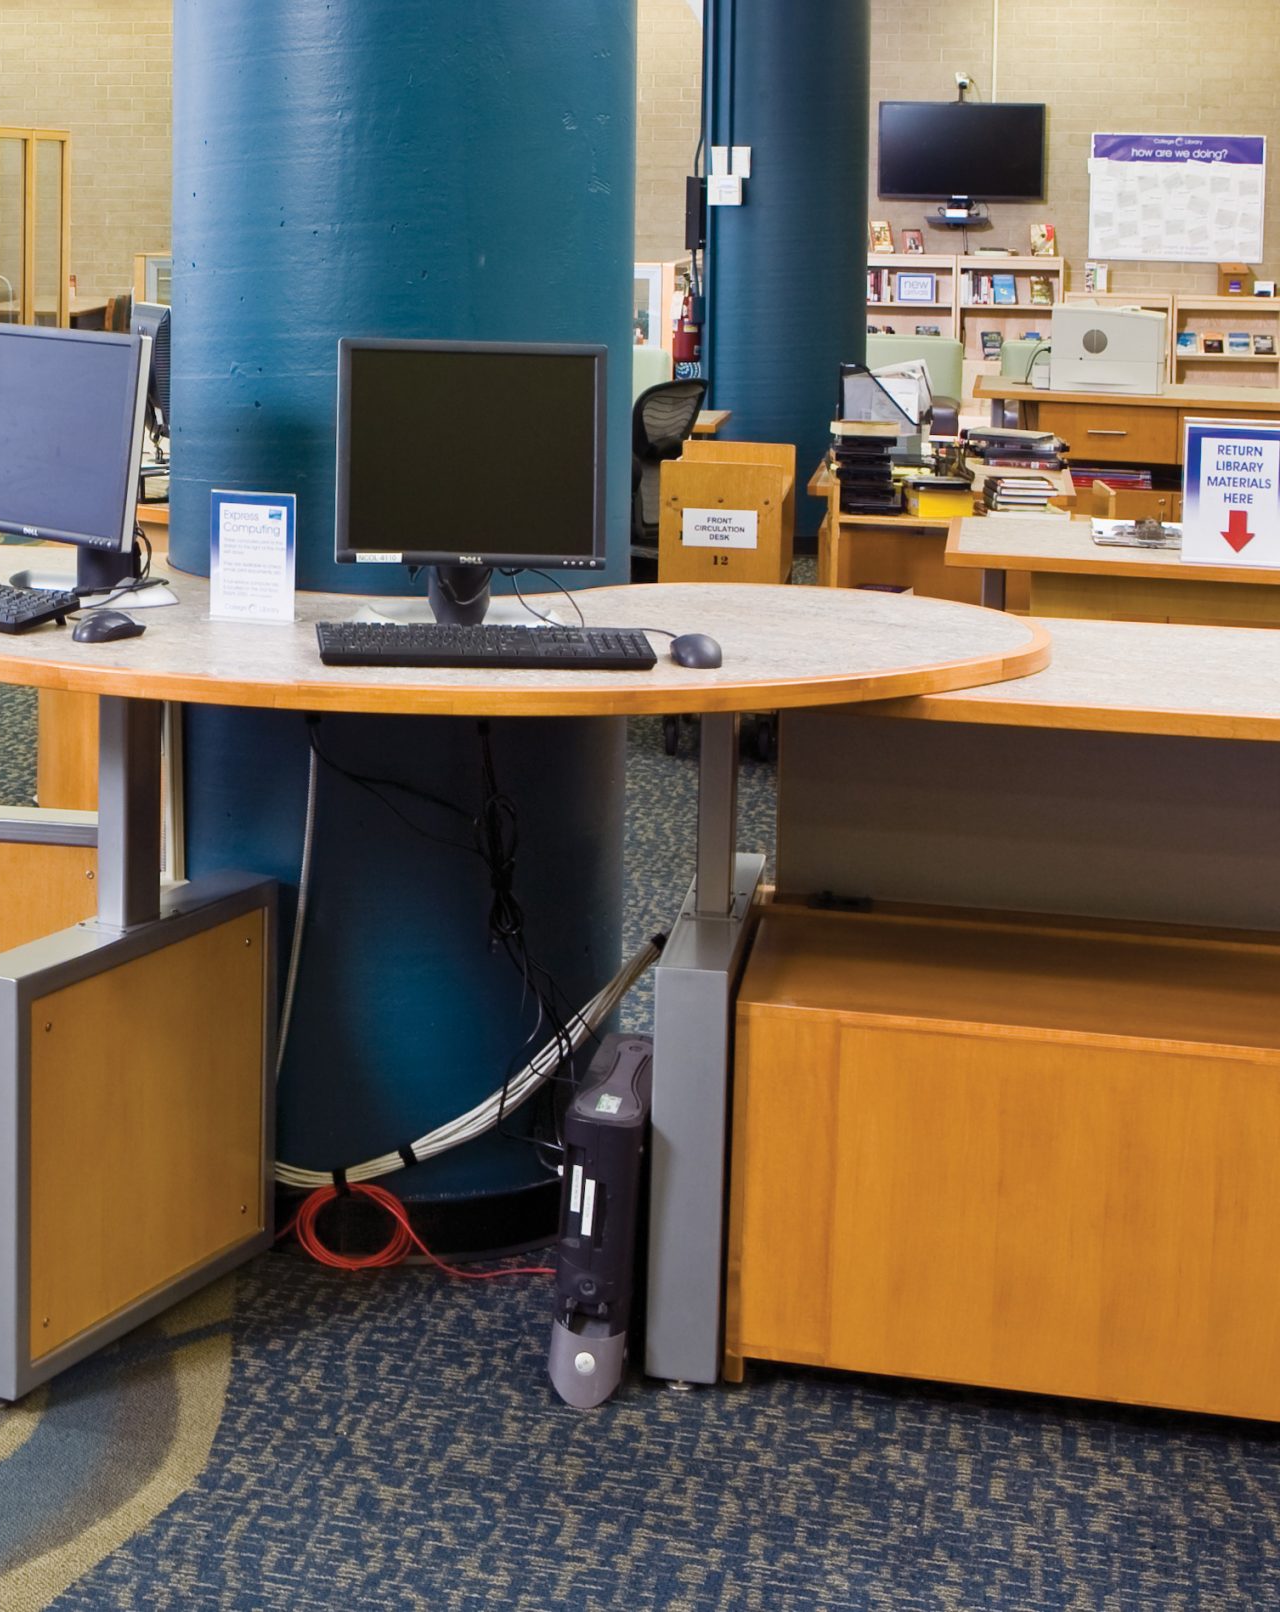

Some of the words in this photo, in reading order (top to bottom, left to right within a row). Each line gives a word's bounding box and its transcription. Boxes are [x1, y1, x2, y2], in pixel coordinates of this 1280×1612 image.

[1184, 138, 1203, 147] Library
[1131, 148, 1153, 158] how
[1155, 149, 1173, 158] are
[1174, 149, 1190, 158] we
[1193, 149, 1228, 161] doing?
[904, 280, 929, 289] new
[1217, 444, 1263, 457] RETURN
[1216, 460, 1264, 473] LIBRARY
[1206, 475, 1272, 490] MATERIALS
[1223, 492, 1254, 504] HERE
[223, 509, 259, 522] Express
[706, 516, 733, 524] FRONT
[22, 527, 39, 537] DELL
[223, 522, 281, 537] Computing
[694, 524, 745, 533] CIRCULATION
[709, 533, 730, 541] DESK
[459, 556, 484, 565] DELL
[712, 555, 729, 566] 12
